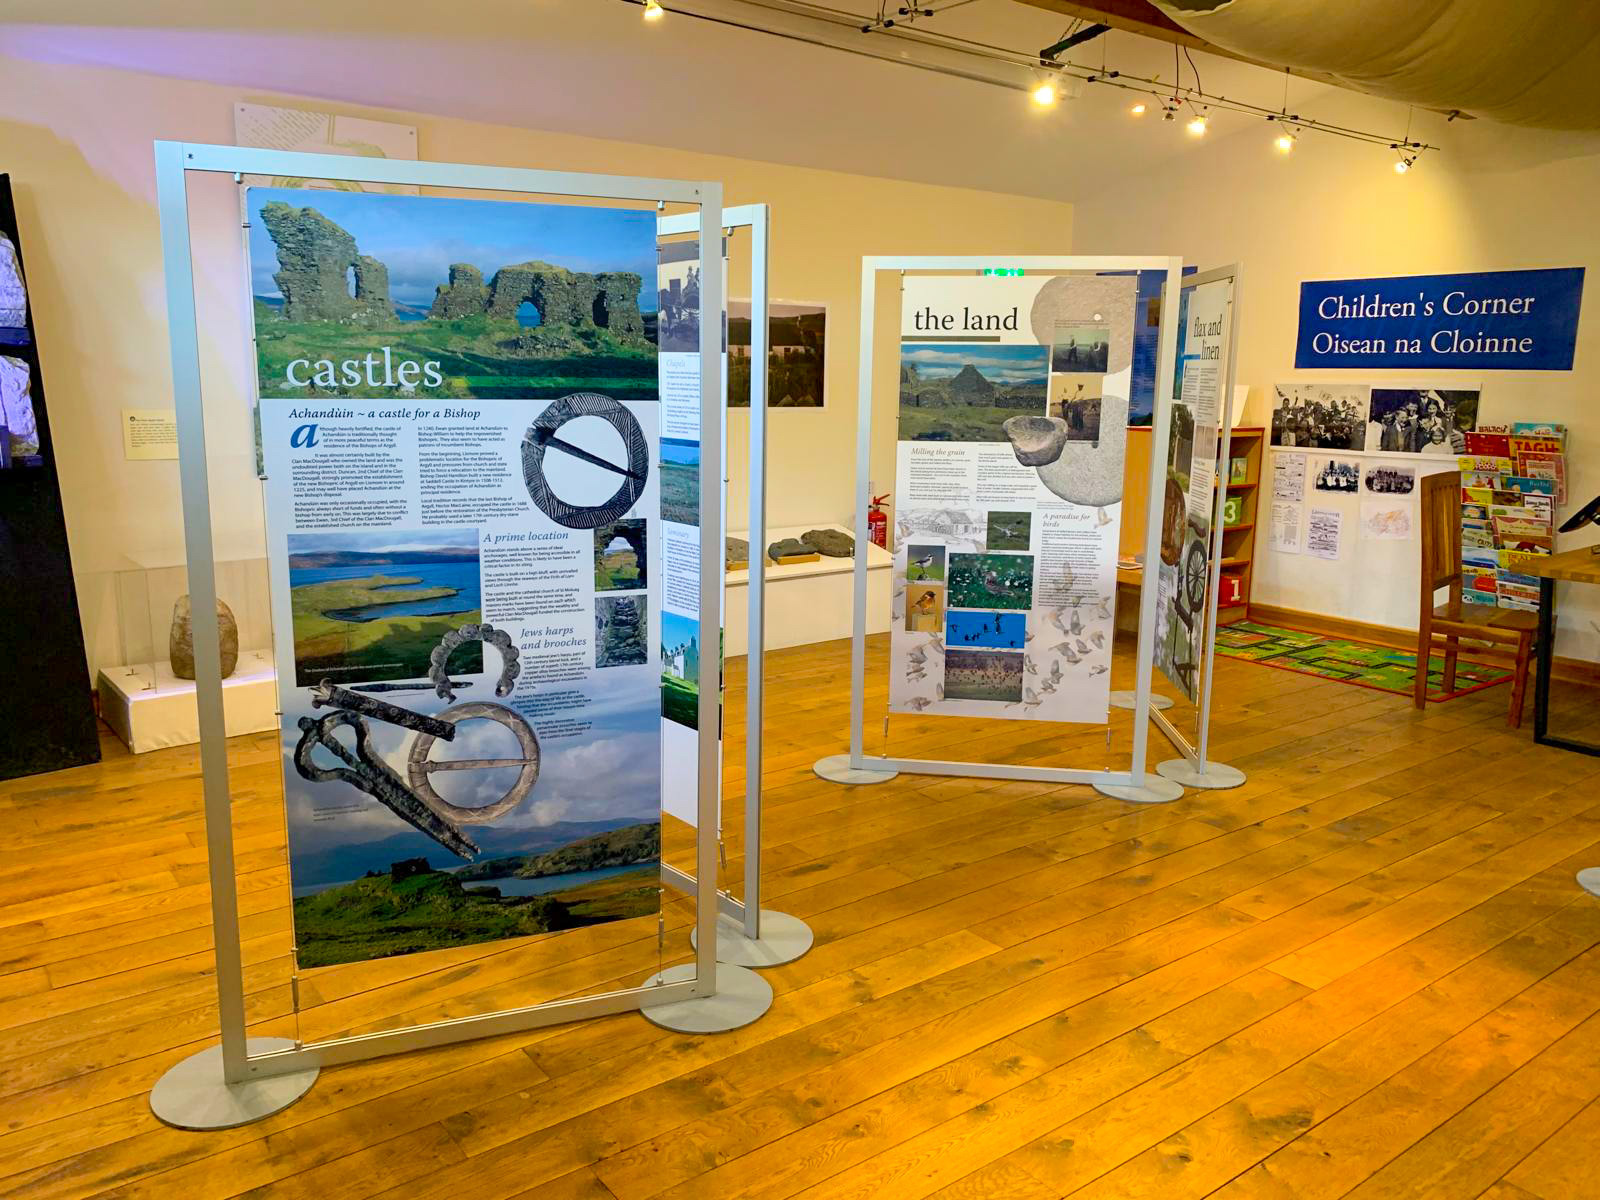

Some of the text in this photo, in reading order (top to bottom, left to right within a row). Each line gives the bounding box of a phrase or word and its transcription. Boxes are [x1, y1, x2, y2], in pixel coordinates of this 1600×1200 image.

[1318, 291, 1536, 319] Children's Corner
[914, 307, 1018, 330] the land
[1194, 313, 1223, 337] flax and
[1201, 339, 1220, 360] linen
[1312, 329, 1533, 354] Oisean na Cloinne
[286, 346, 443, 388] castles
[289, 408, 354, 419] Achandùin
[368, 410, 375, 418] a
[379, 408, 412, 418] castle
[412, 408, 430, 420] for
[433, 410, 440, 418] a
[444, 408, 481, 420] Bishop
[912, 448, 935, 457] Milling
[947, 449, 966, 457] grain
[1050, 513, 1079, 521] paradise
[1079, 513, 1090, 521] for
[1224, 501, 1236, 522] 3
[483, 531, 569, 544] A prime location
[1231, 580, 1240, 601] 1
[520, 626, 574, 639] Jews harps
[521, 637, 587, 650] and brooches
